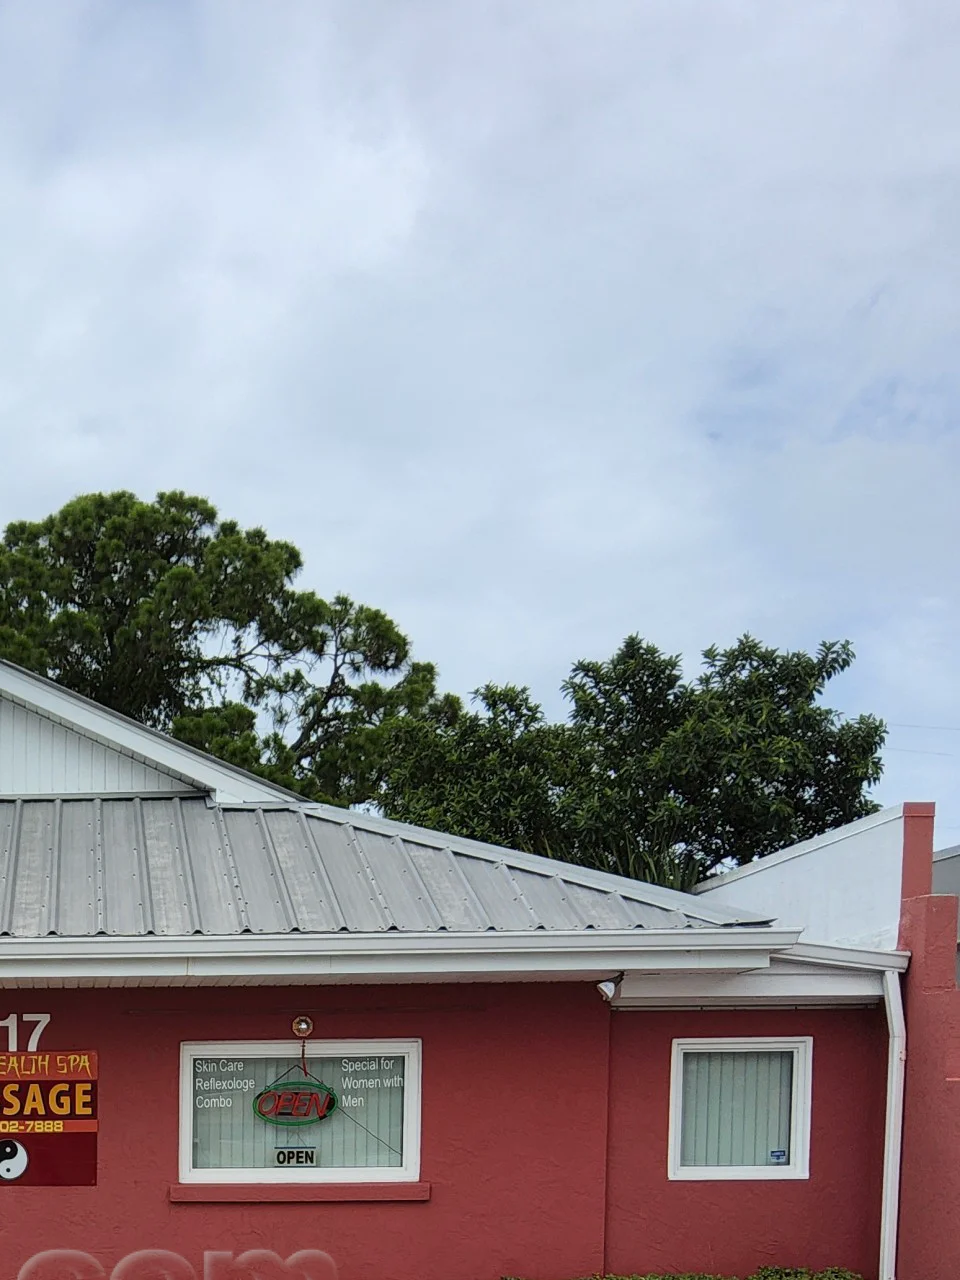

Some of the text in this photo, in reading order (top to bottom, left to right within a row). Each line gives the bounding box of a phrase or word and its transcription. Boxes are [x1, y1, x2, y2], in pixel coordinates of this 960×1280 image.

[56, 1055, 92, 1079] SPA
[195, 1059, 244, 1073] Skin Care
[341, 1058, 395, 1073] Special for
[195, 1078, 256, 1092] Reflexologe
[341, 1076, 404, 1090] Women with
[196, 1096, 233, 1108] Combo
[257, 1091, 331, 1117] OPEN
[342, 1095, 364, 1108] Men
[276, 1150, 315, 1164] OPEN
